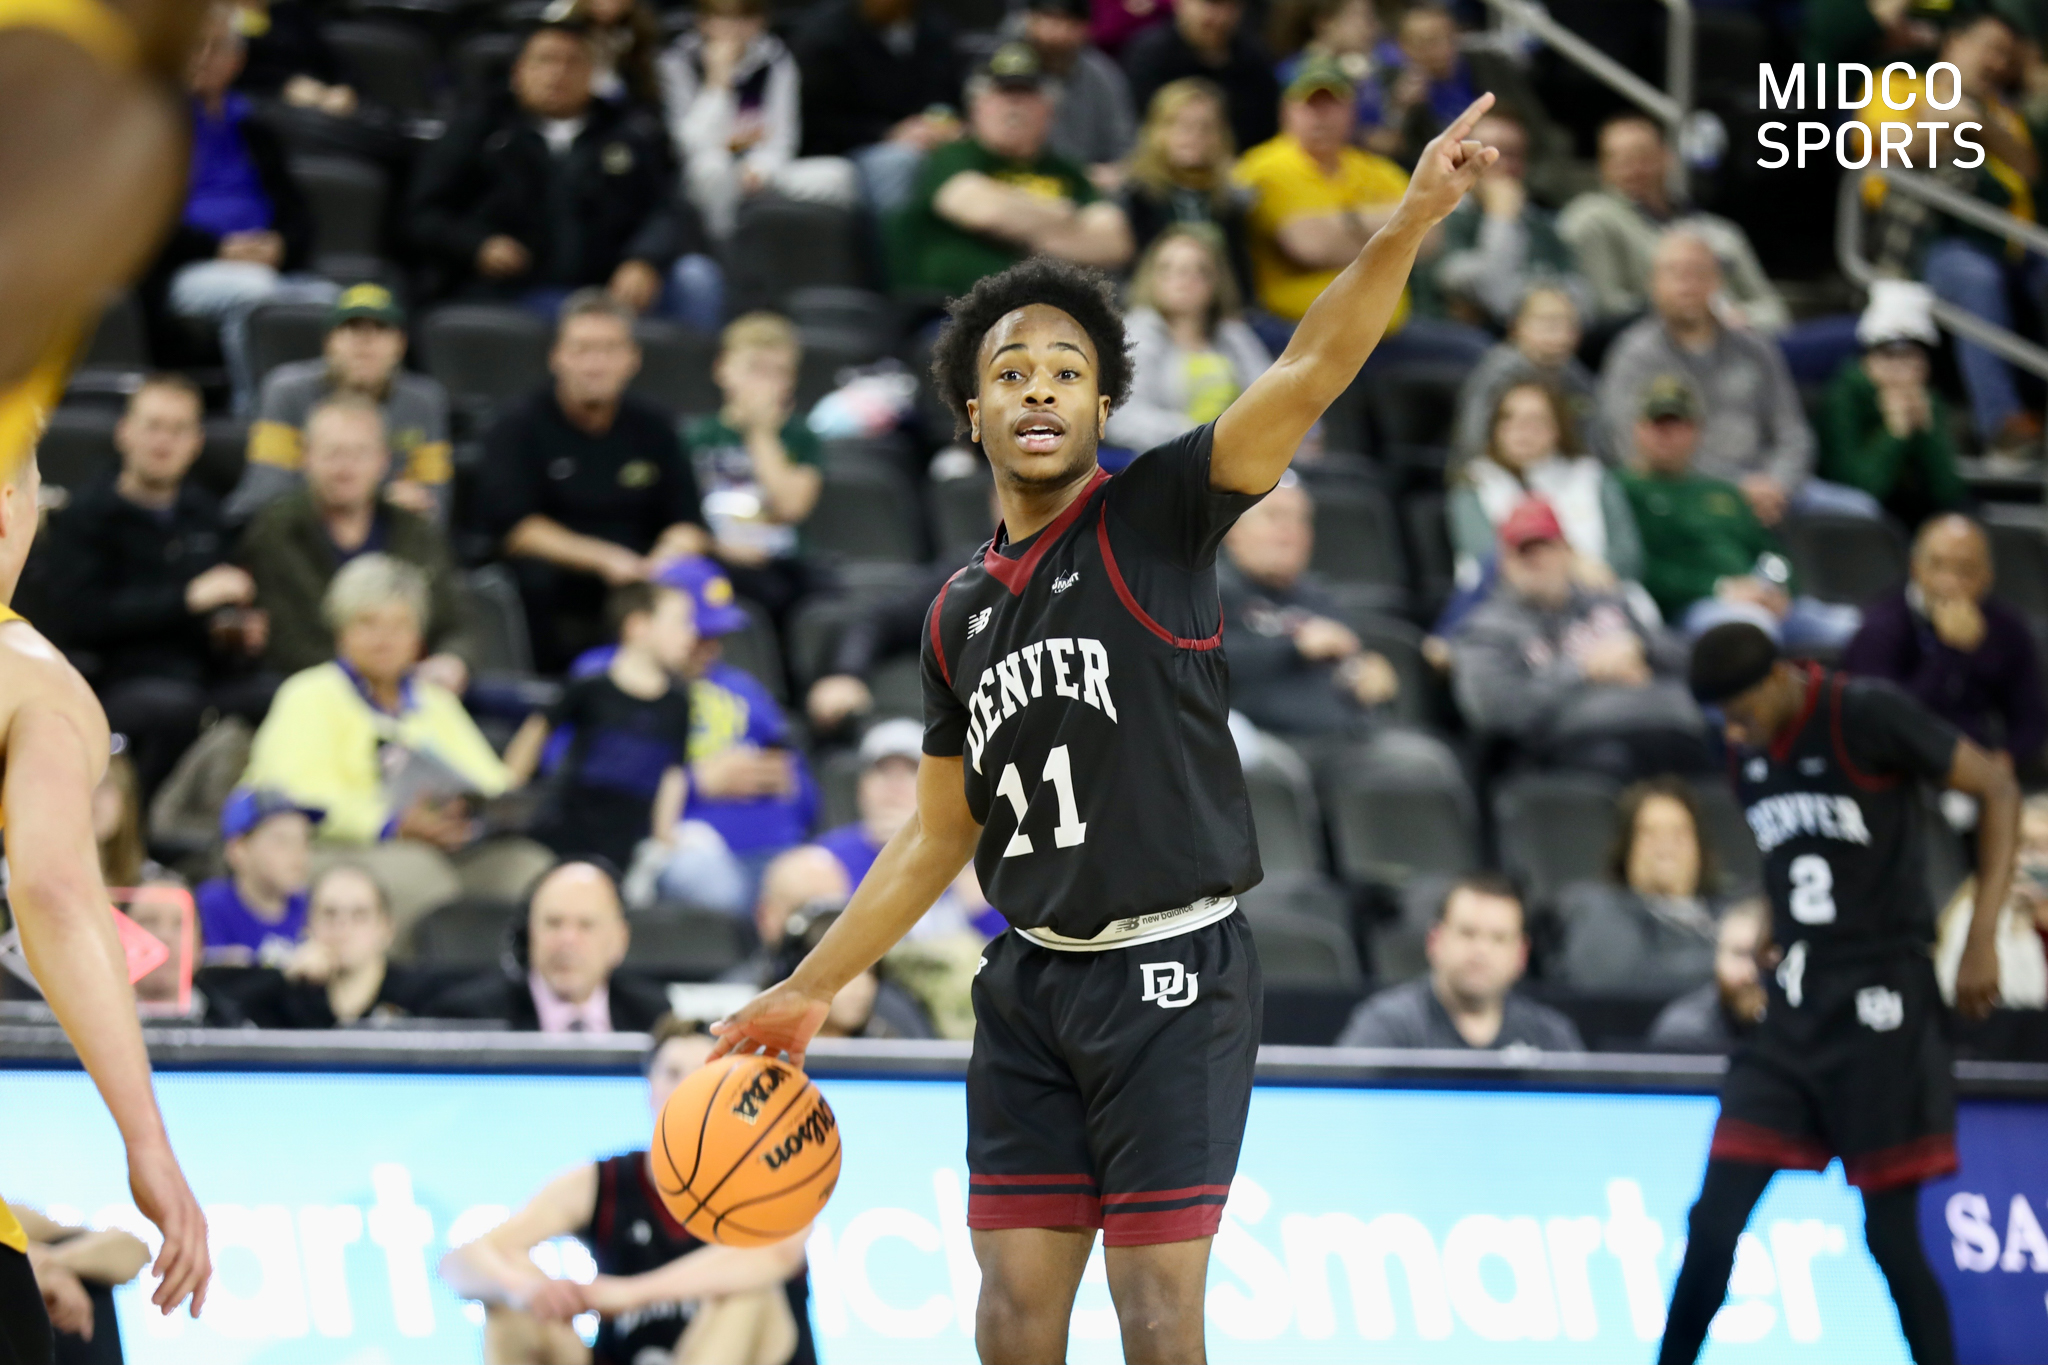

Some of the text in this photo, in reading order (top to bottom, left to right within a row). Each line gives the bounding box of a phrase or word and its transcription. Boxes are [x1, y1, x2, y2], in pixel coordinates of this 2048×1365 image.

[966, 637, 1118, 776] DENVER
[996, 744, 1087, 858] 11
[1142, 914, 1160, 924] new
[1161, 904, 1194, 920] balance
[1789, 854, 1836, 924] 2
[1140, 961, 1199, 1008] DU
